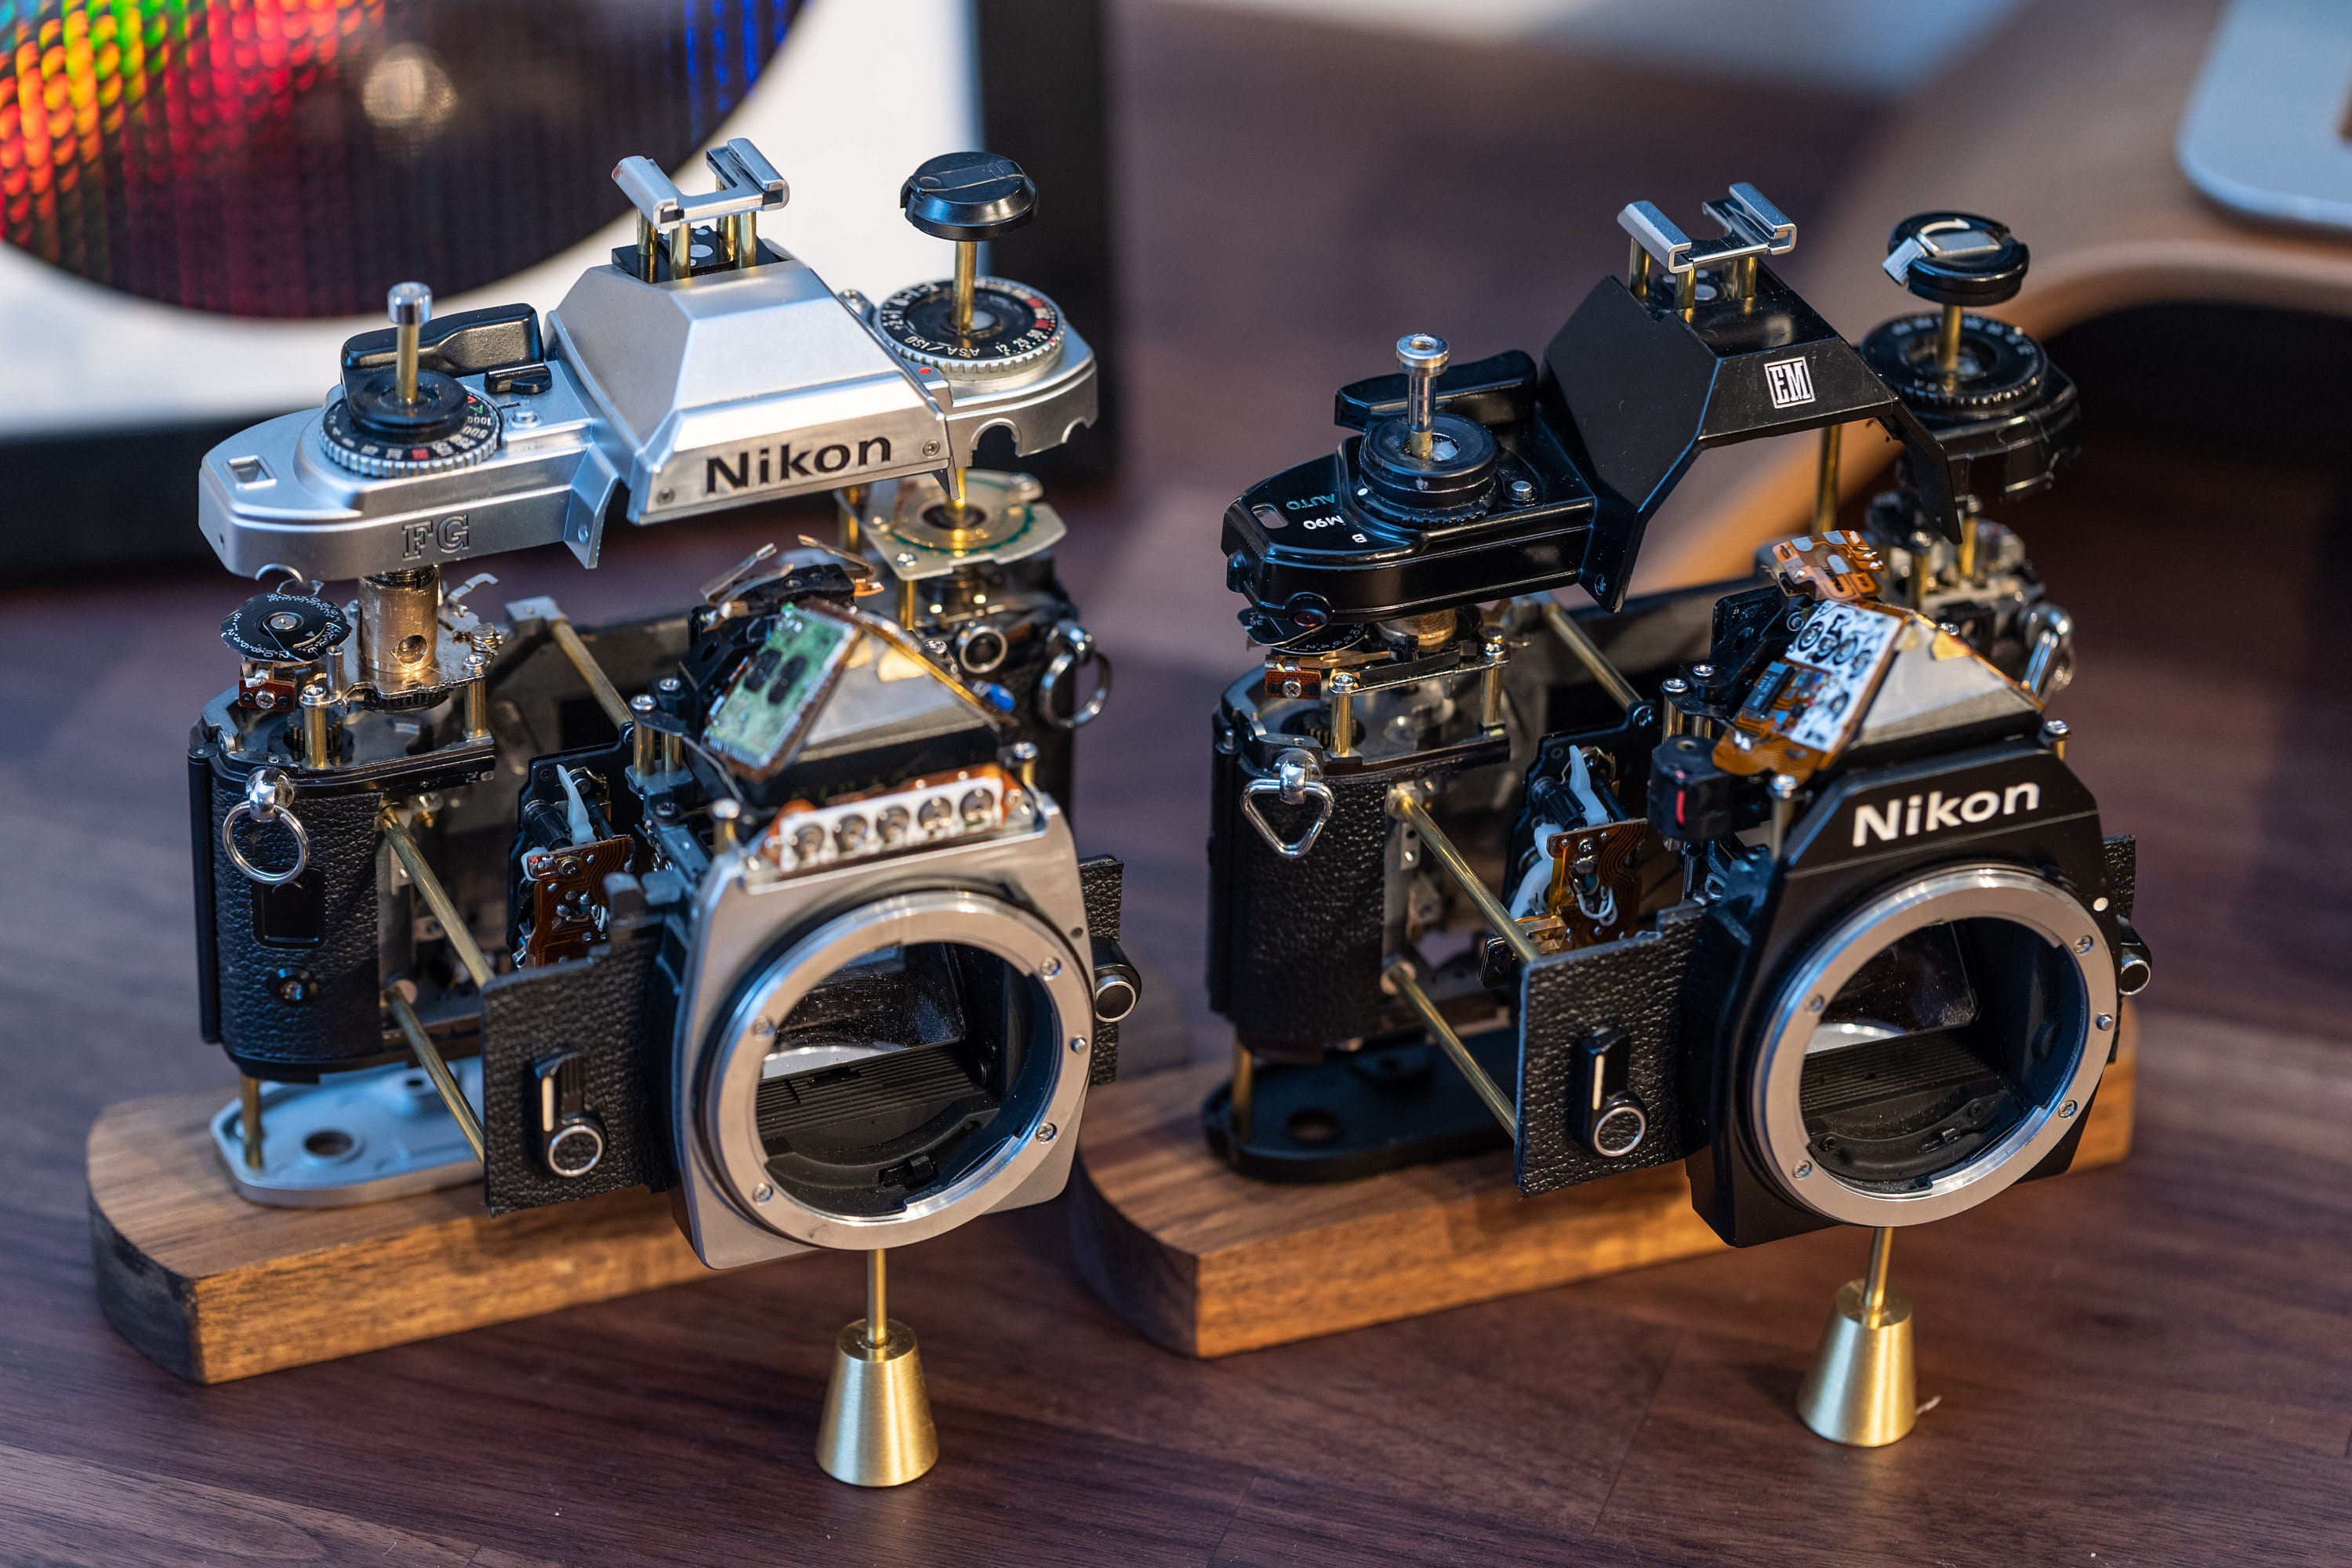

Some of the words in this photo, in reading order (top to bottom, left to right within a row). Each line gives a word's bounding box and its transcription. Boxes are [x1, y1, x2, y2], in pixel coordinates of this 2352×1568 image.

[1768, 360, 1813, 407] EM
[467, 416, 492, 426] 1000
[706, 436, 891, 494] Nikon
[1287, 493, 1334, 510] AUTO
[1303, 515, 1345, 530] M90
[401, 514, 470, 561] FG
[1352, 533, 1367, 543] B
[267, 593, 279, 602] 36
[263, 649, 275, 658] 10
[1852, 782, 2041, 848] Nikon
